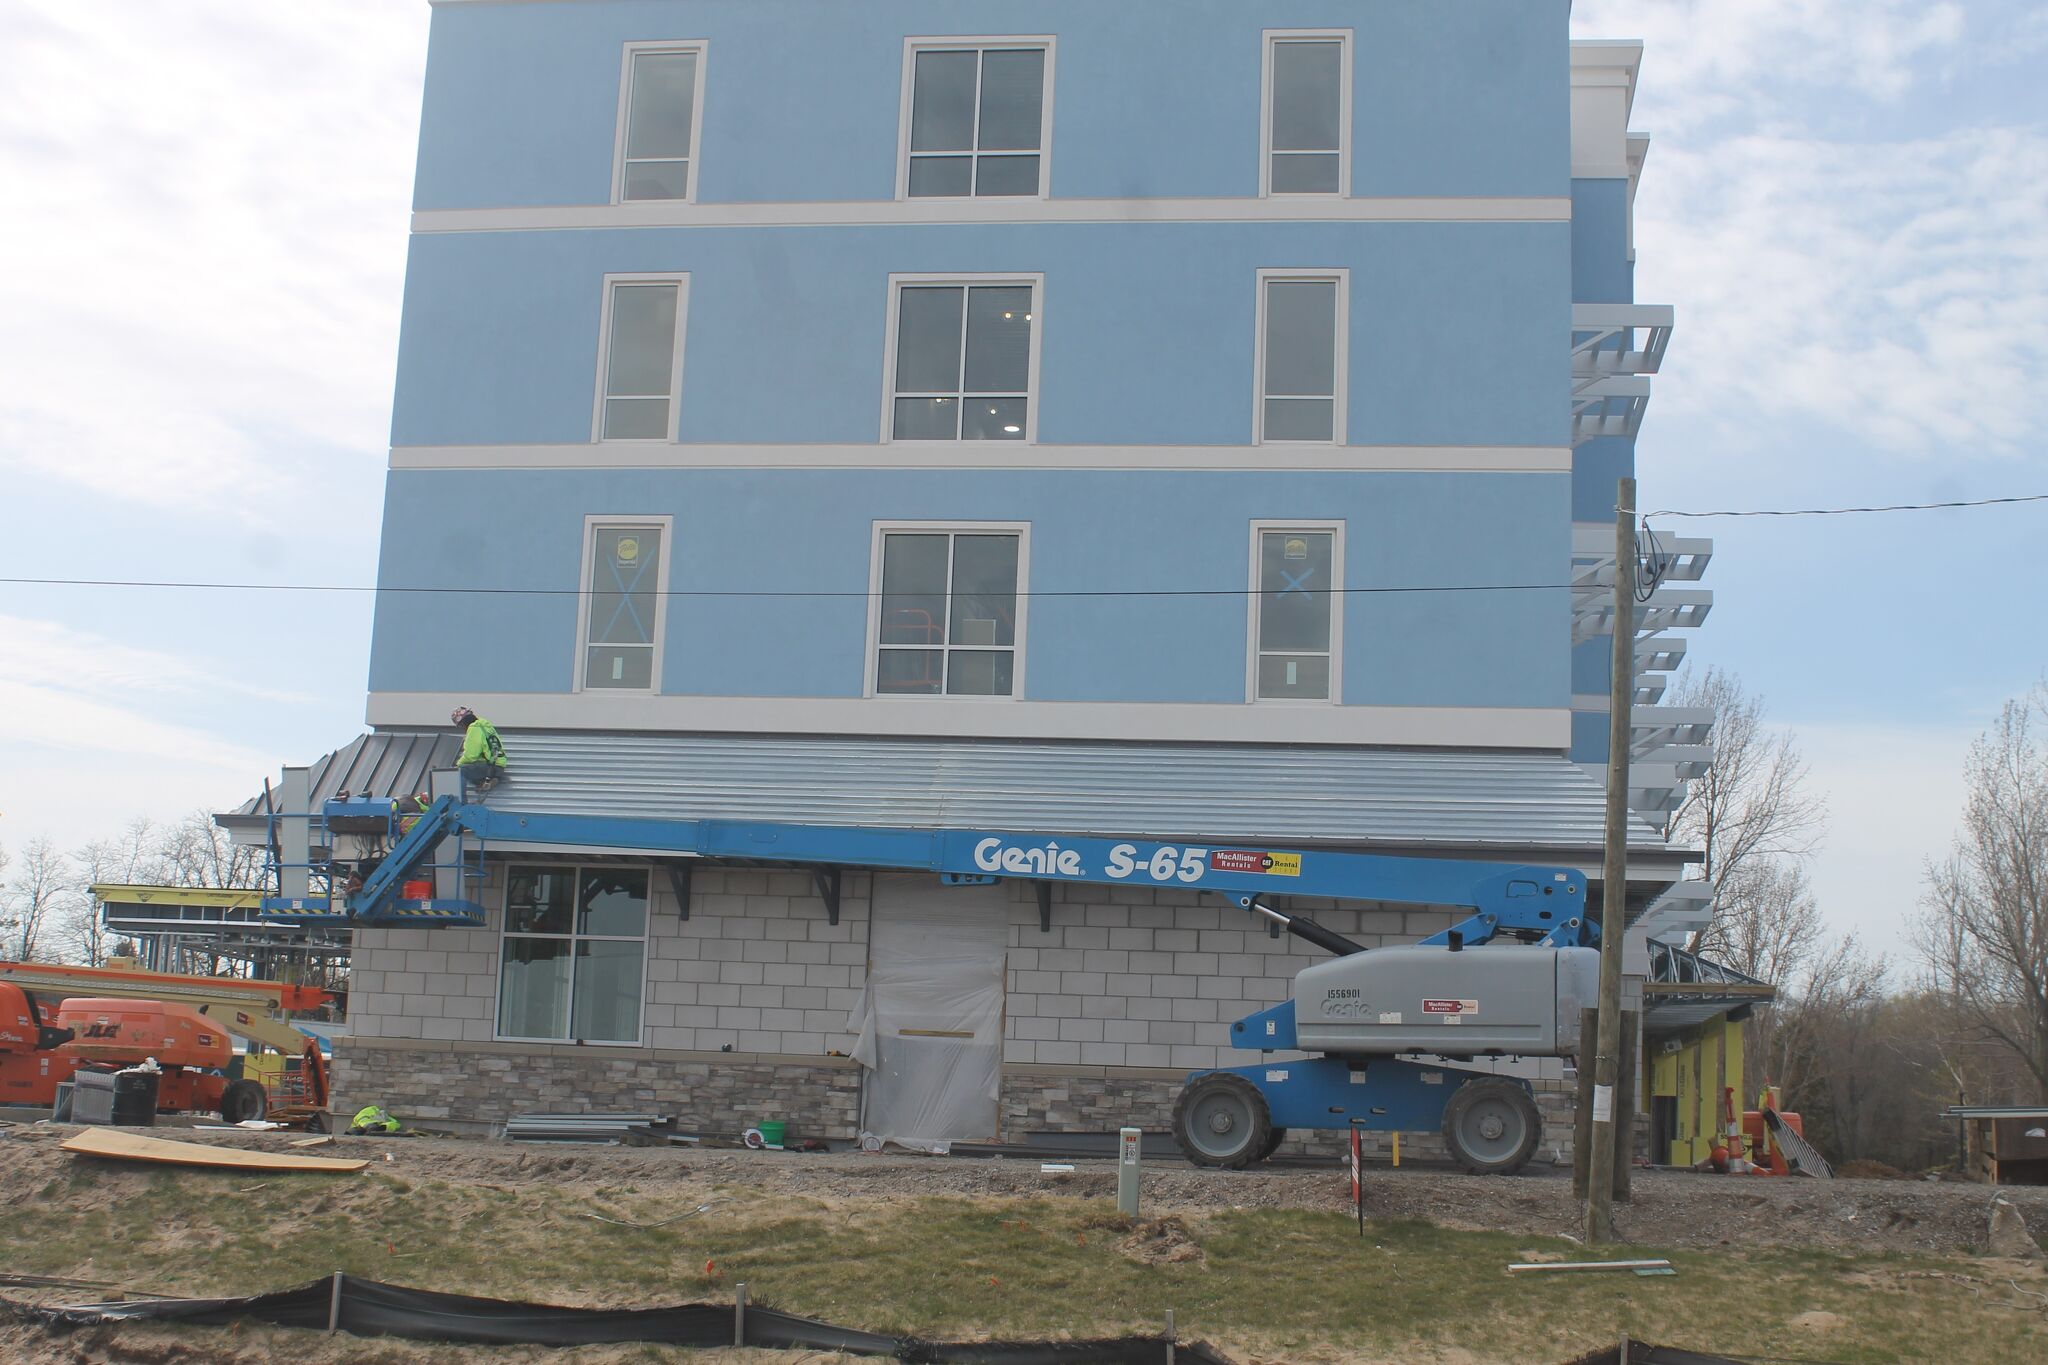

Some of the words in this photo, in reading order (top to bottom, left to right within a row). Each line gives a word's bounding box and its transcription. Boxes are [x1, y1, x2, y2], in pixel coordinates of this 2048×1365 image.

[974, 837, 1081, 876] Genie
[1104, 843, 1208, 883] S-65
[1216, 852, 1257, 862] MacAllister
[1221, 860, 1251, 869] Rentals
[1274, 860, 1298, 868] Rental
